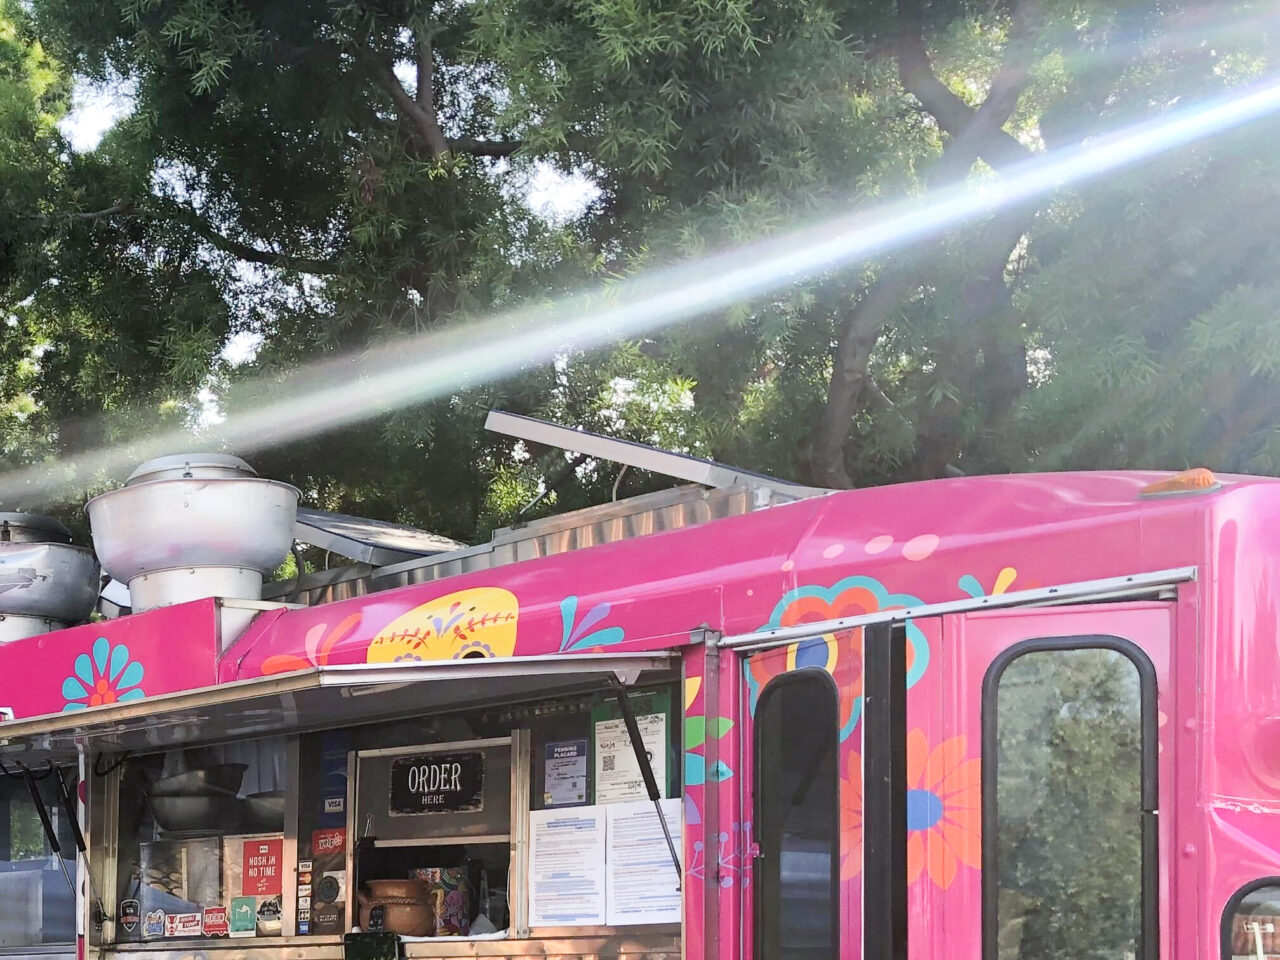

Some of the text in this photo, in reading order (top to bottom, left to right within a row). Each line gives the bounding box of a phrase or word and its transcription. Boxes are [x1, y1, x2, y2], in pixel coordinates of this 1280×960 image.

[408, 763, 462, 792] ORDER
[421, 794, 445, 805] HERE
[249, 856, 276, 866] NOSH IN
[248, 866, 276, 877] NO TIME
